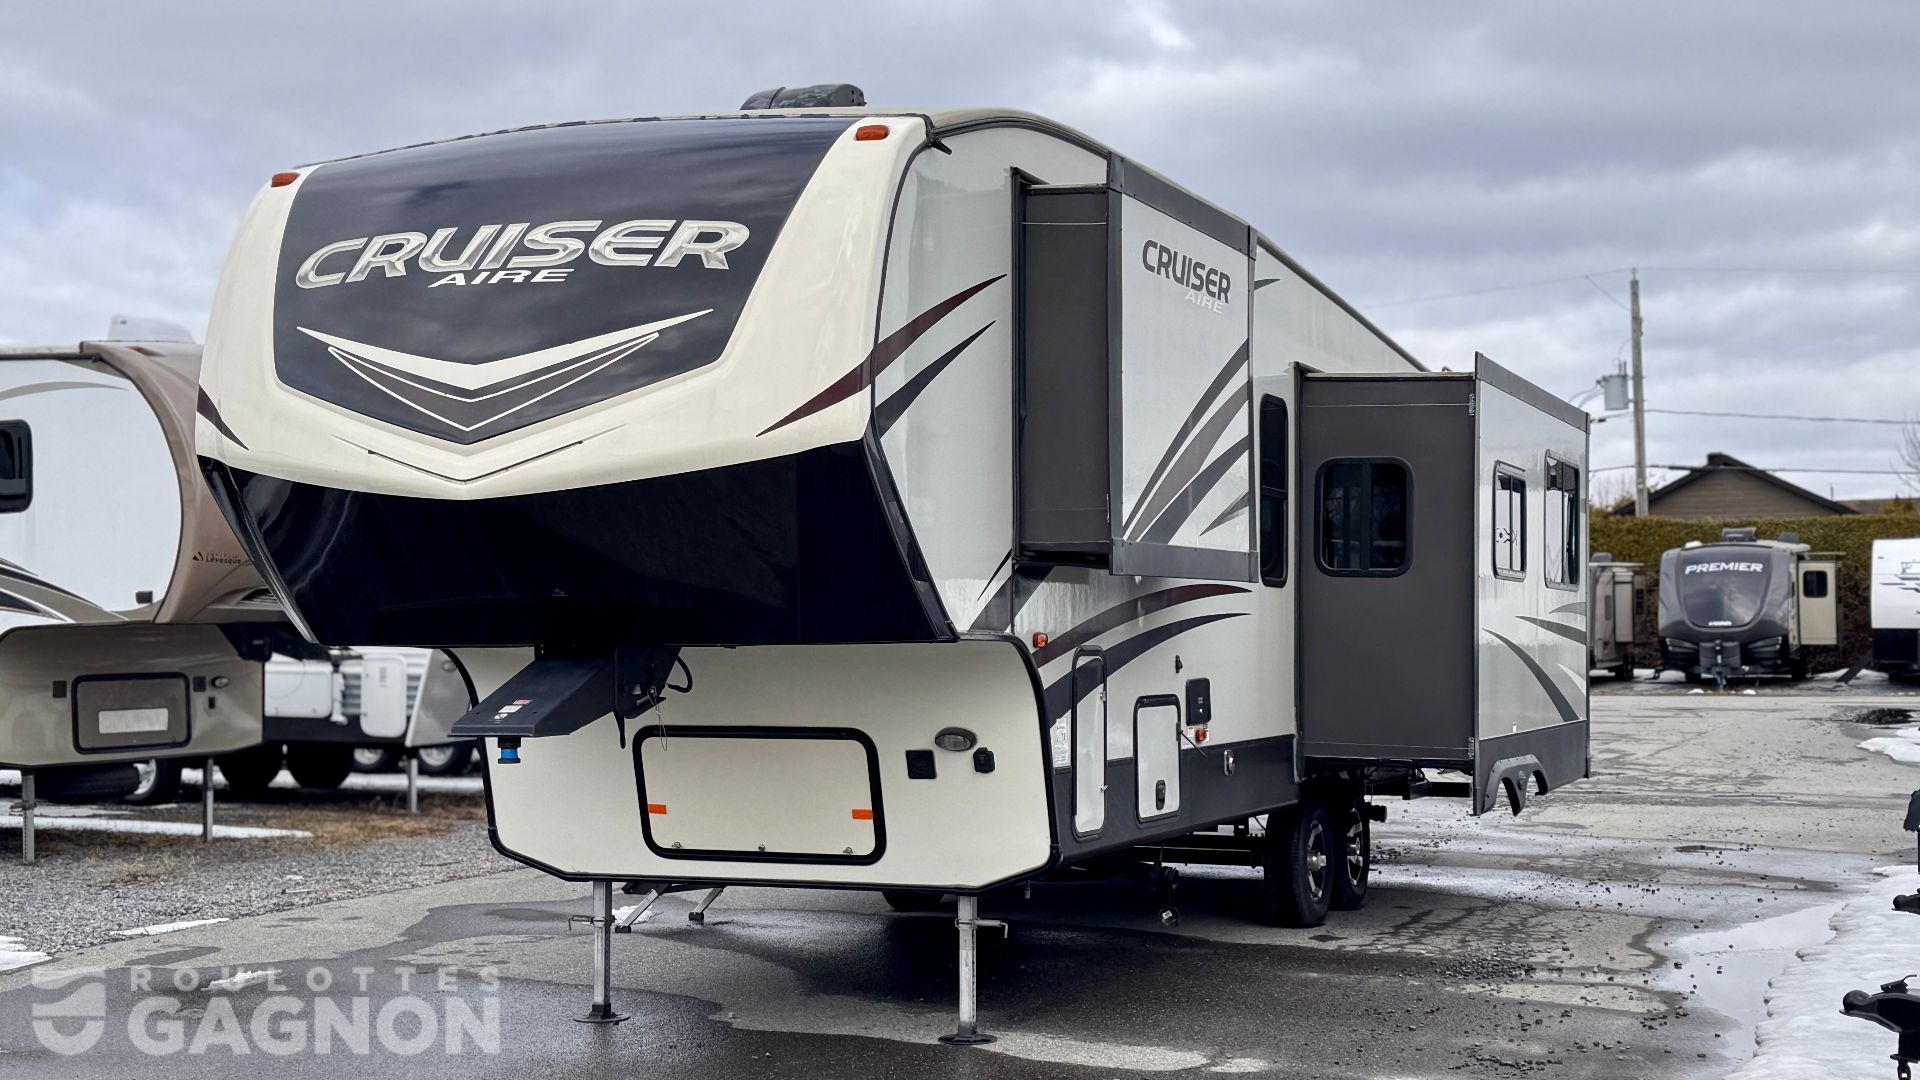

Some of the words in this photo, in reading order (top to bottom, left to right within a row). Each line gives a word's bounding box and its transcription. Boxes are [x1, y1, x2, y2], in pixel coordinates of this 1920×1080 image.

[296, 218, 750, 289] CRUISER
[428, 268, 574, 288] AIRE
[1143, 239, 1231, 304] CRUISER
[1184, 290, 1225, 314] AIRE
[1685, 562, 1763, 574] PREMIER
